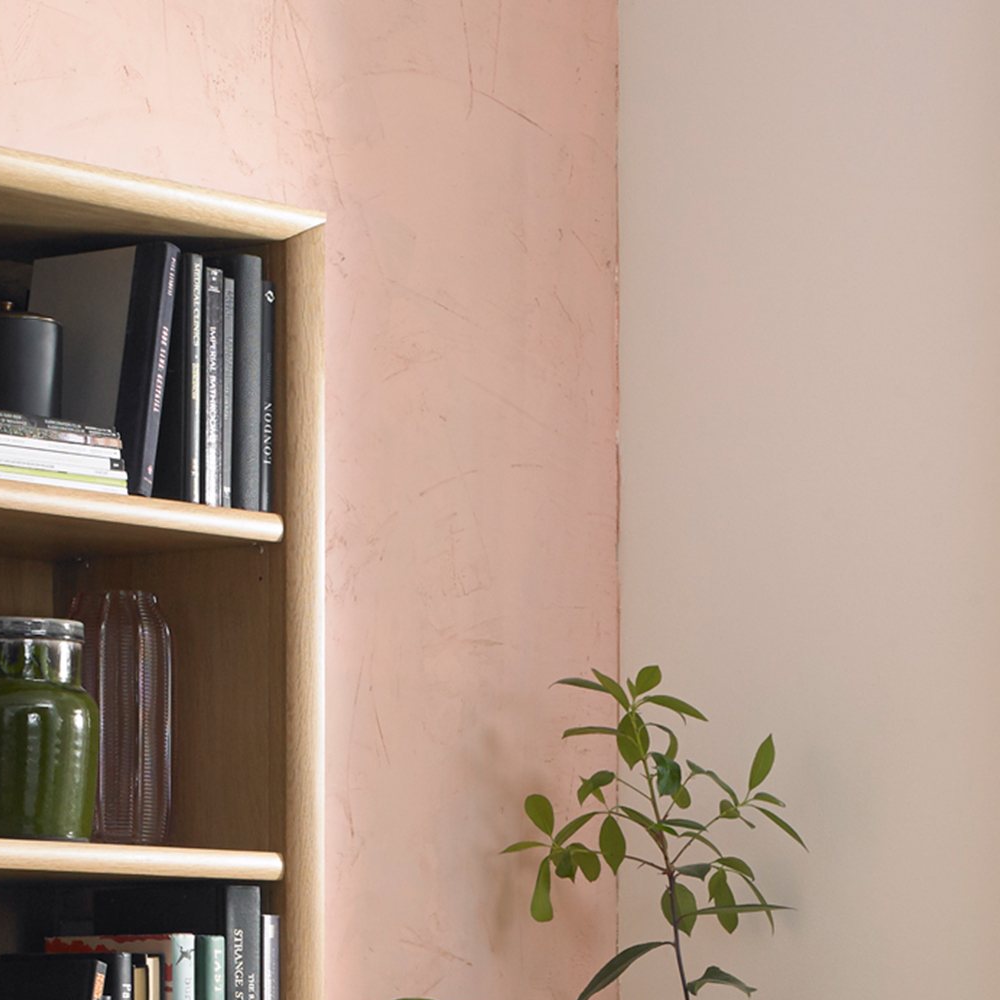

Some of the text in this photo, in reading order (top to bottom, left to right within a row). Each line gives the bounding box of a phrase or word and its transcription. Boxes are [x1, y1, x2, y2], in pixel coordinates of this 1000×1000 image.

[192, 262, 200, 347] MEDICAL CLINICS
[208, 326, 217, 373] IMPERIAL
[264, 401, 272, 464] LONDON
[214, 949, 222, 992] LAST
[233, 928, 243, 987] STRANGE
